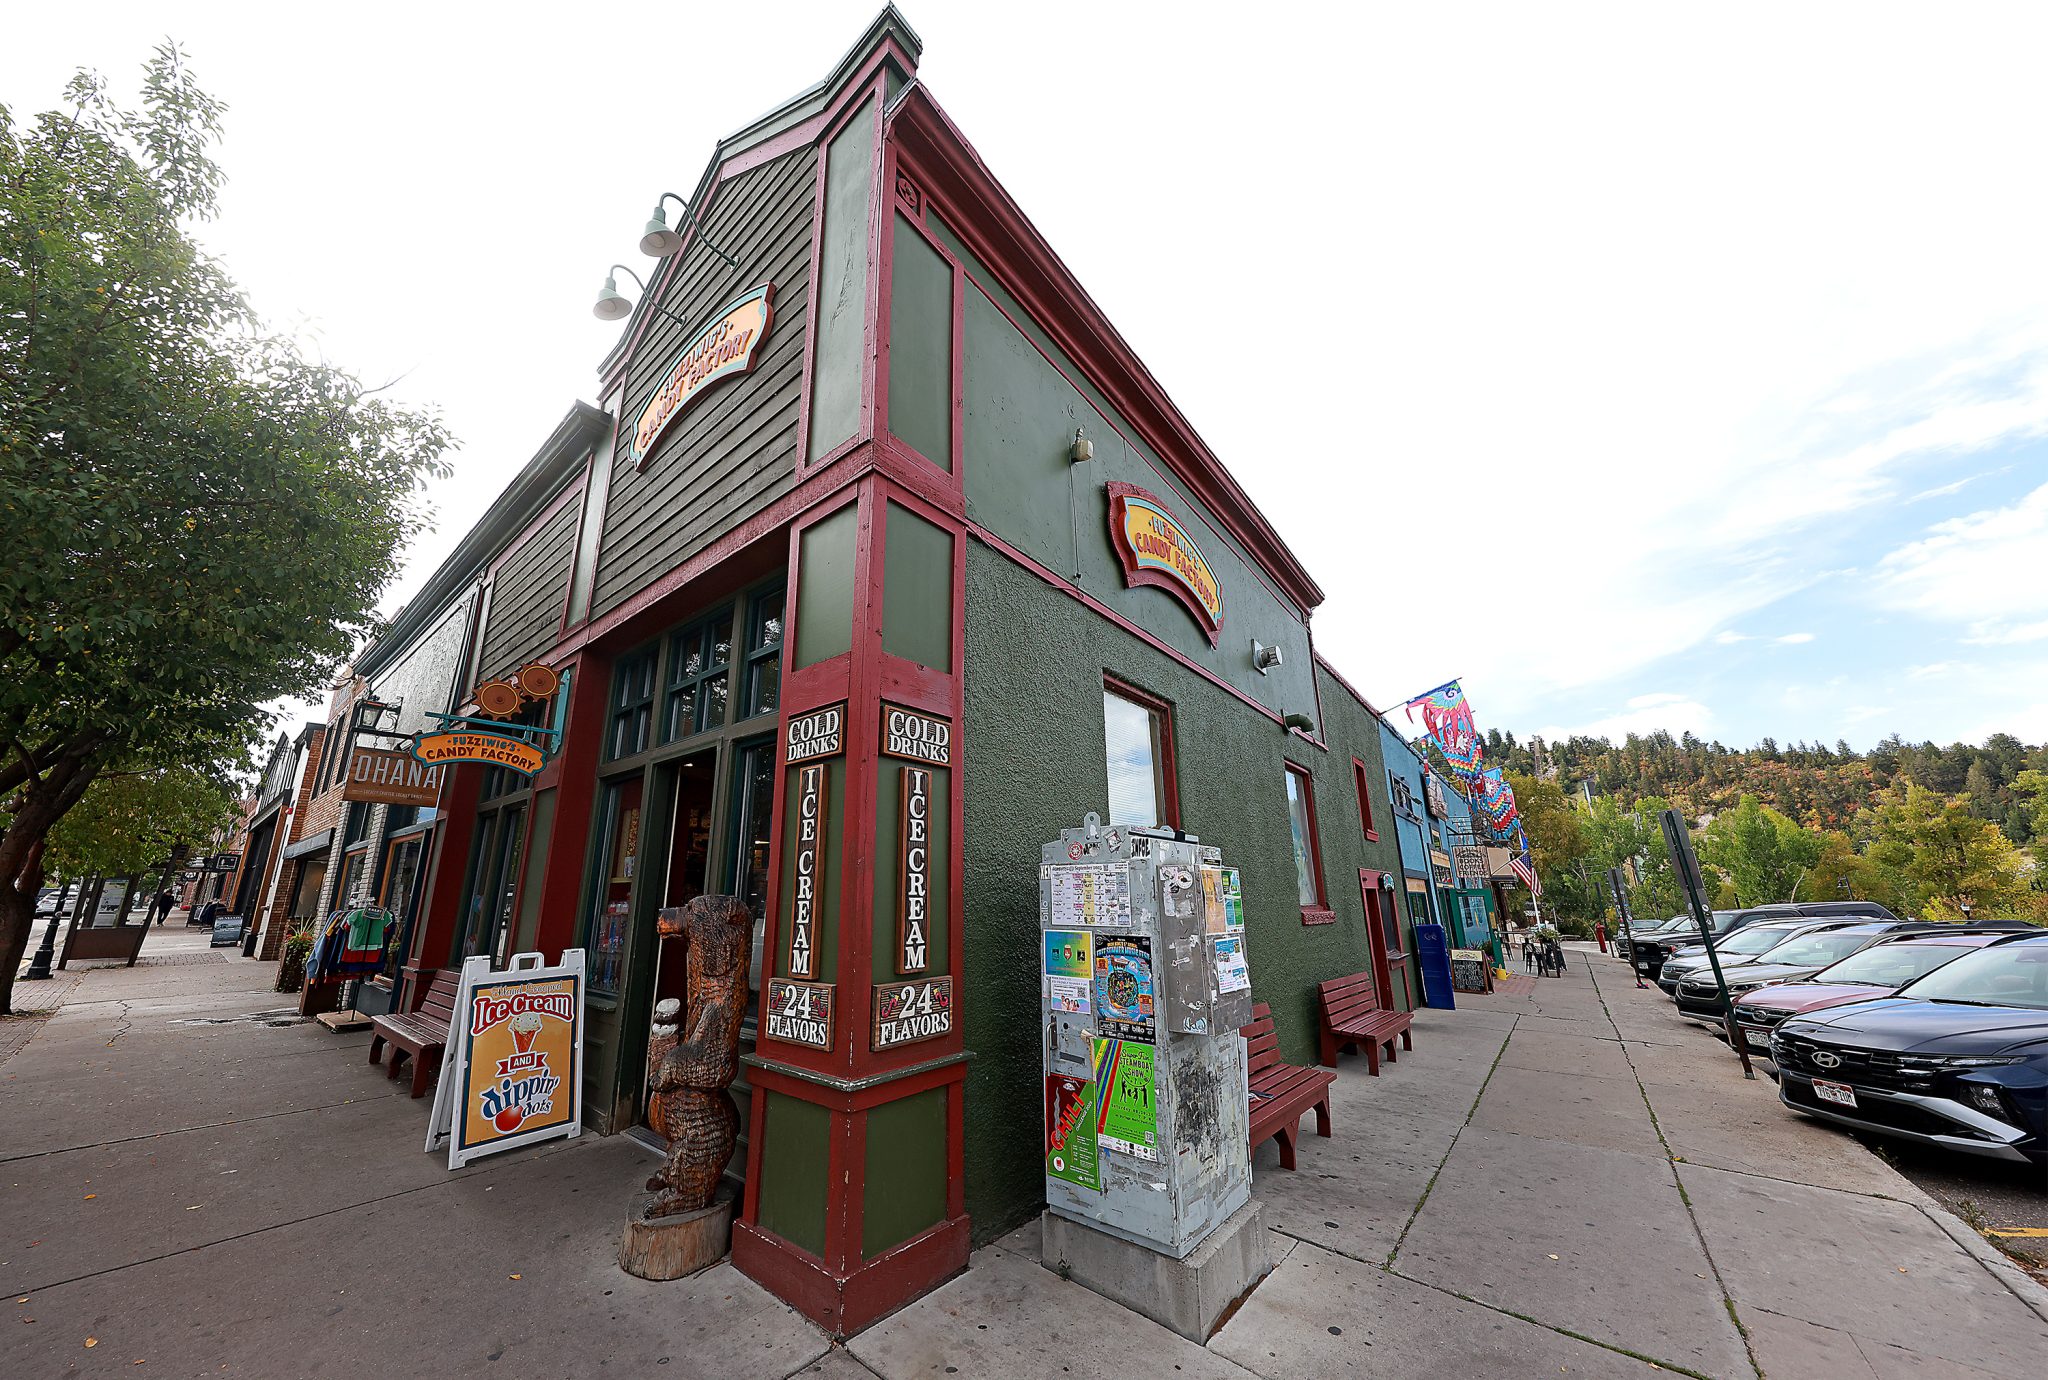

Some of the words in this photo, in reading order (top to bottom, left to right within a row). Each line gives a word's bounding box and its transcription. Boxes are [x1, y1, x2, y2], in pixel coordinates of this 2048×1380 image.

[662, 319, 730, 399] FUZZIWIG'S
[639, 379, 685, 448] CANDY
[687, 328, 754, 390] FACTORY
[1151, 515, 1201, 571] FUZZIWIG'S
[1134, 532, 1173, 562] CANDY
[1175, 551, 1216, 610] FACTORY
[452, 735, 517, 752] FUZZIWIG'S
[788, 710, 839, 745] COLD
[889, 711, 949, 747] COLD
[425, 746, 476, 760] CANDY
[480, 747, 536, 770] FACTORY
[787, 733, 839, 762] DRINKS
[888, 734, 949, 764] DRINKS
[354, 754, 437, 790] OHANA
[801, 768, 817, 842] ICE
[909, 770, 927, 842] ICE
[791, 850, 814, 975] CREAM
[904, 848, 927, 970] CREAM
[475, 998, 508, 1030] Ice
[512, 995, 570, 1017] Cream
[783, 984, 812, 1019] 24
[898, 982, 933, 1019] 24
[768, 1014, 827, 1045] FLAVORS
[879, 1011, 950, 1046] FLAVORS
[513, 1056, 532, 1067] AND
[1119, 1057, 1153, 1070] STEAMBOAT
[1127, 1067, 1145, 1079] SHOW
[481, 1068, 560, 1119] dippin'
[522, 1099, 552, 1118] dots
[1050, 1091, 1086, 1151] CHILI
